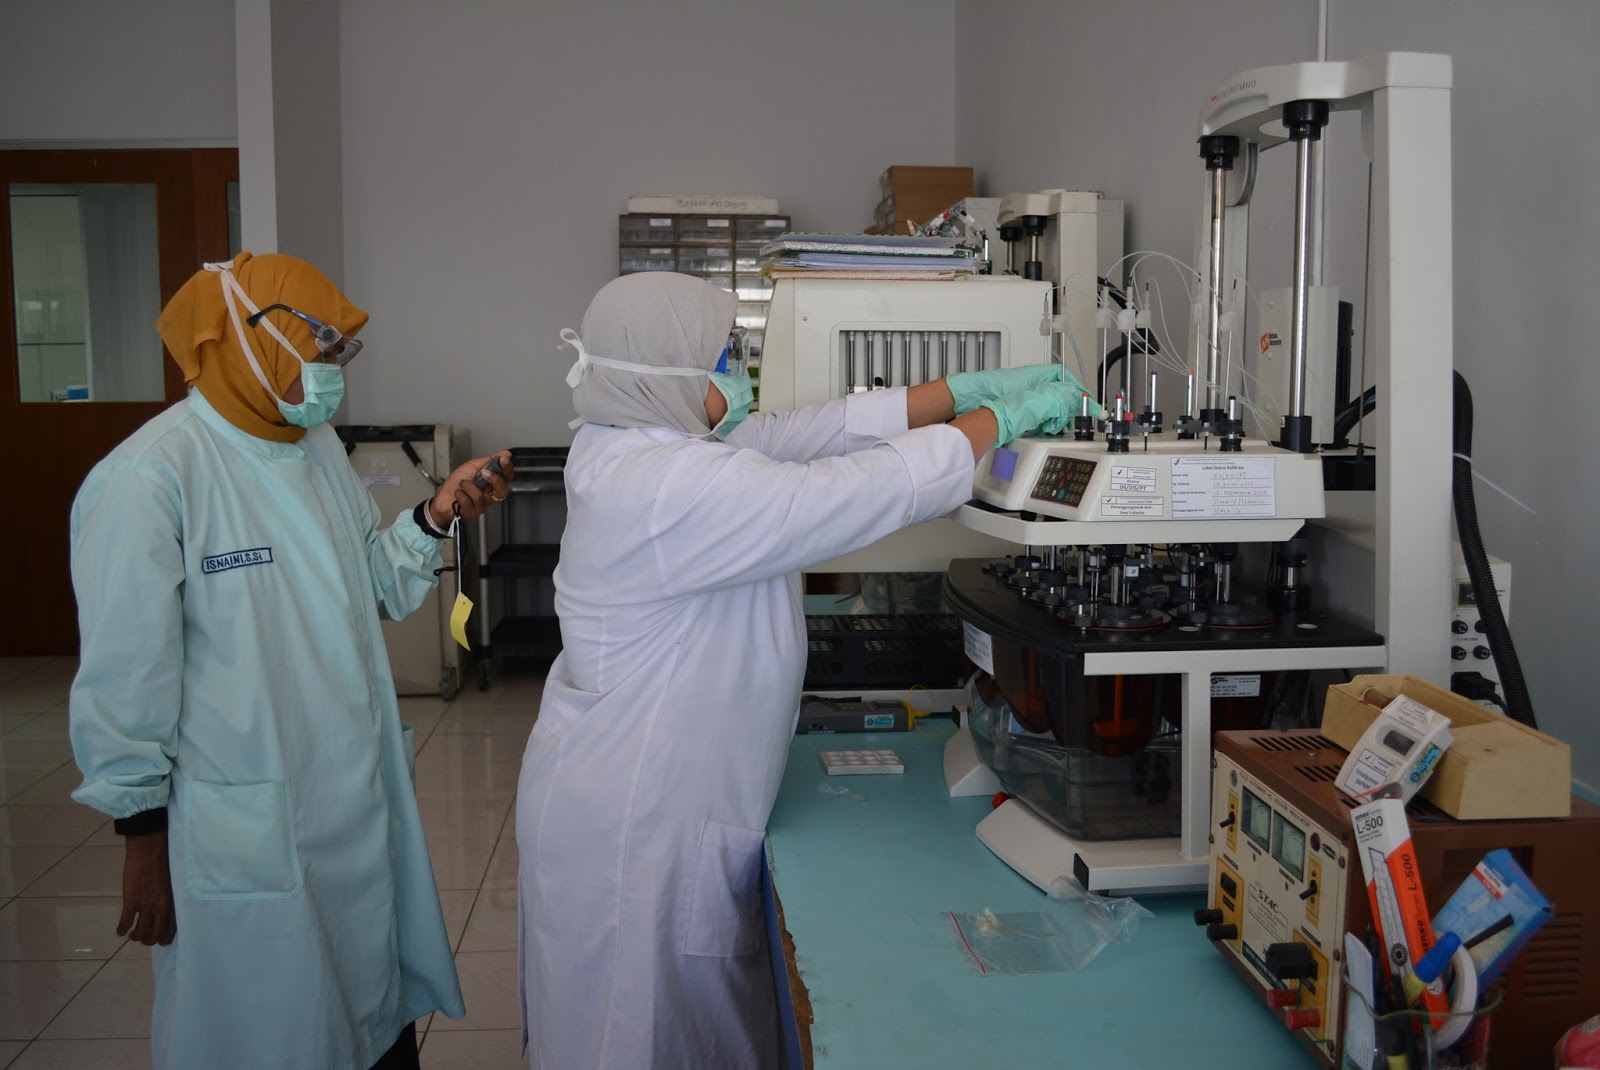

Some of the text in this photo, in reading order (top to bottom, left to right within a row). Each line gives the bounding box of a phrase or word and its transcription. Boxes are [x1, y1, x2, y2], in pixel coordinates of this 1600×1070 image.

[1356, 815, 1384, 835] L-500
[1401, 853, 1418, 891] L-500
[1257, 889, 1279, 914] STAC
